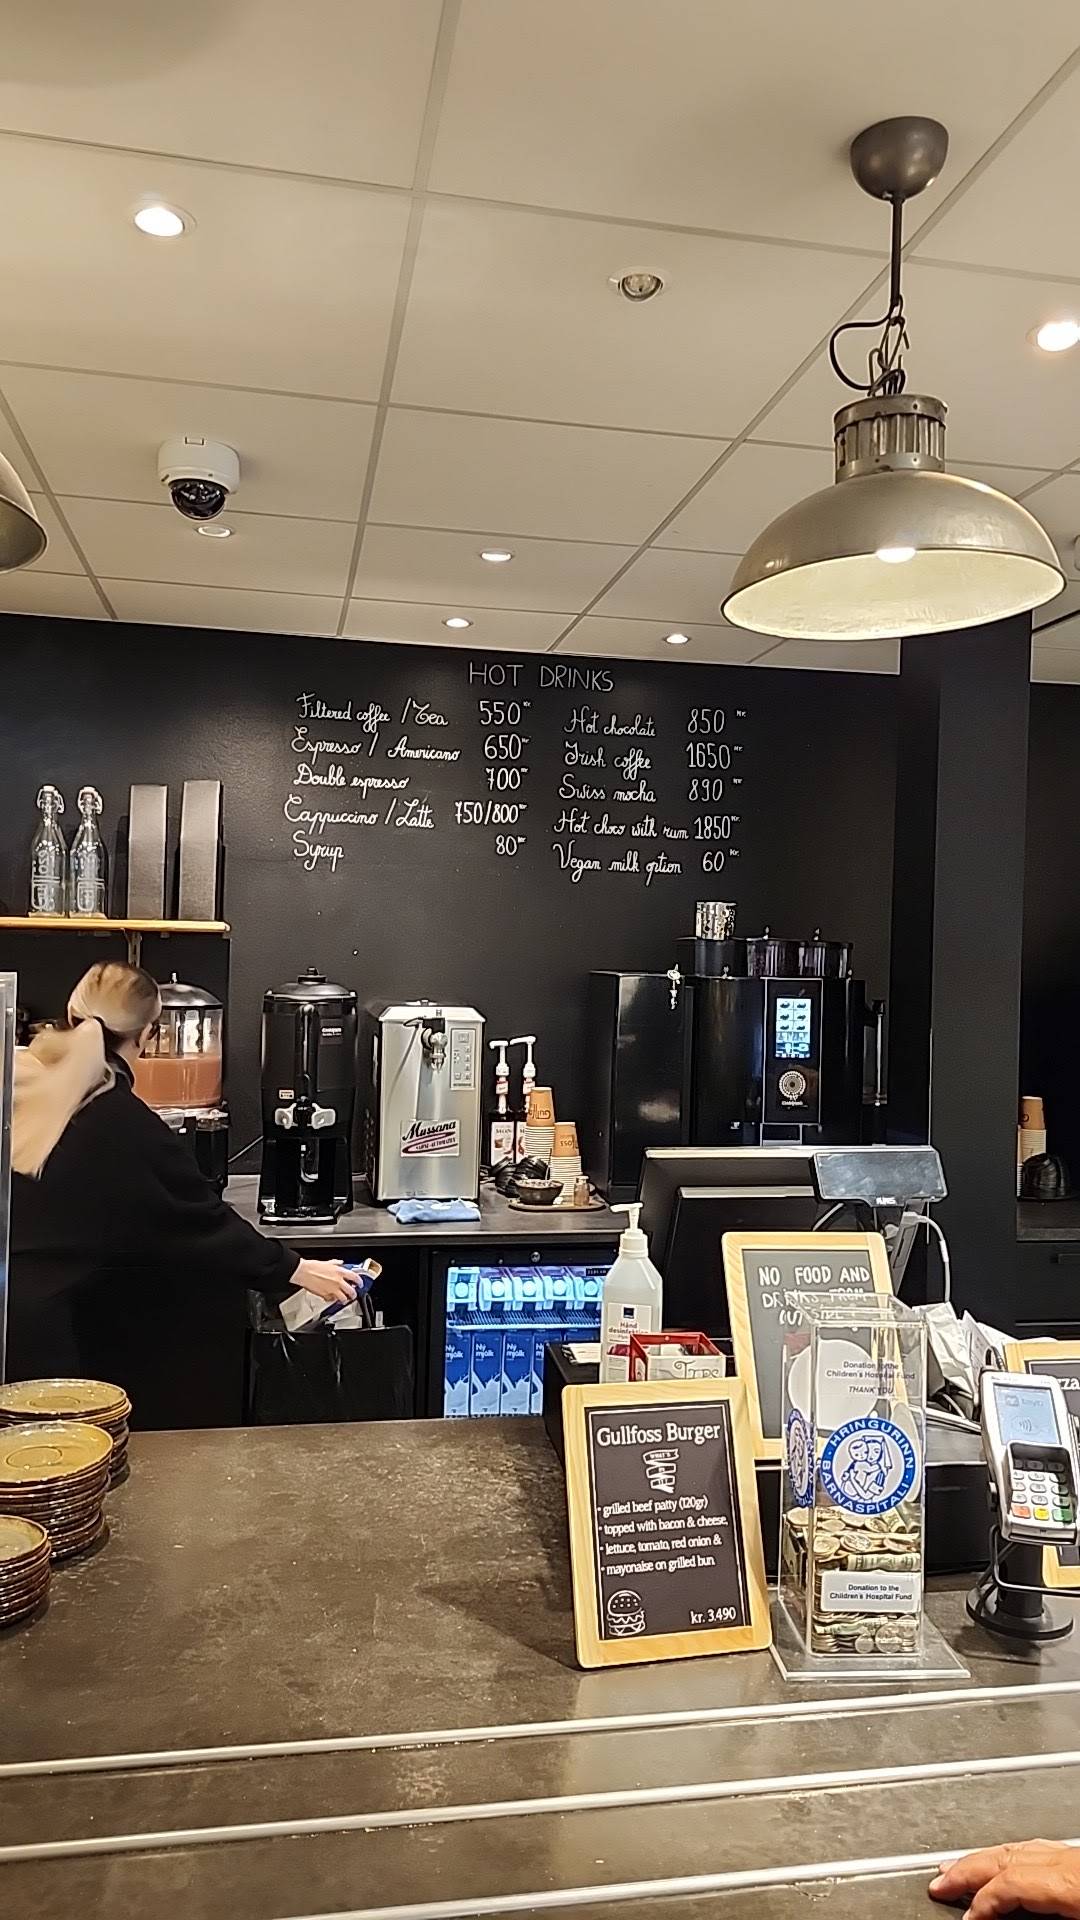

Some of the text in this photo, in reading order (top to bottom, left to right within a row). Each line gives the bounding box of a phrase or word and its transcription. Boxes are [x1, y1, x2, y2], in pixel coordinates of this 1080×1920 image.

[469, 661, 614, 692] HOT DRINKS
[296, 692, 352, 721] Filtered
[356, 703, 391, 733] coffee
[564, 706, 600, 734] Hot
[603, 714, 656, 737] chocolate
[688, 709, 725, 734] 850
[291, 726, 362, 765] Espresso
[388, 736, 462, 761] Americano
[565, 741, 606, 768] Irish
[614, 748, 651, 781] coffee
[686, 742, 731, 770] 1650
[293, 763, 347, 788] Double
[350, 777, 409, 799] espresso
[559, 774, 606, 800] Swiss
[613, 780, 656, 803] mocha
[688, 779, 723, 802] 890
[284, 794, 379, 835] Cappuccino
[554, 808, 590, 833] Hot
[594, 814, 625, 835] choco
[631, 815, 657, 837] with
[663, 825, 689, 840] rum
[293, 831, 344, 873] Syrup
[553, 840, 601, 883] Vegan
[608, 850, 640, 873] milk
[646, 852, 682, 887] option
[702, 851, 725, 872] 60
[402, 1121, 456, 1141] Mussana
[758, 1266, 871, 1286] NO FOOD AND
[826, 1370, 863, 1378] Children's
[843, 1361, 875, 1369] Donation
[597, 1422, 721, 1446] Gullfoss Burger
[830, 1419, 914, 1469] HRINGURINN
[603, 1495, 708, 1518] grilled beef patty (120gr)
[604, 1515, 728, 1537] topped with bacon & cheese,
[606, 1543, 637, 1555] lettuce,
[671, 1536, 686, 1549] red
[688, 1536, 711, 1547] onion
[713, 1534, 722, 1545] &
[606, 1561, 654, 1577] mayonaise
[655, 1561, 667, 1570] on
[668, 1555, 696, 1572] grilled
[690, 1606, 737, 1625] kr. 3.490
